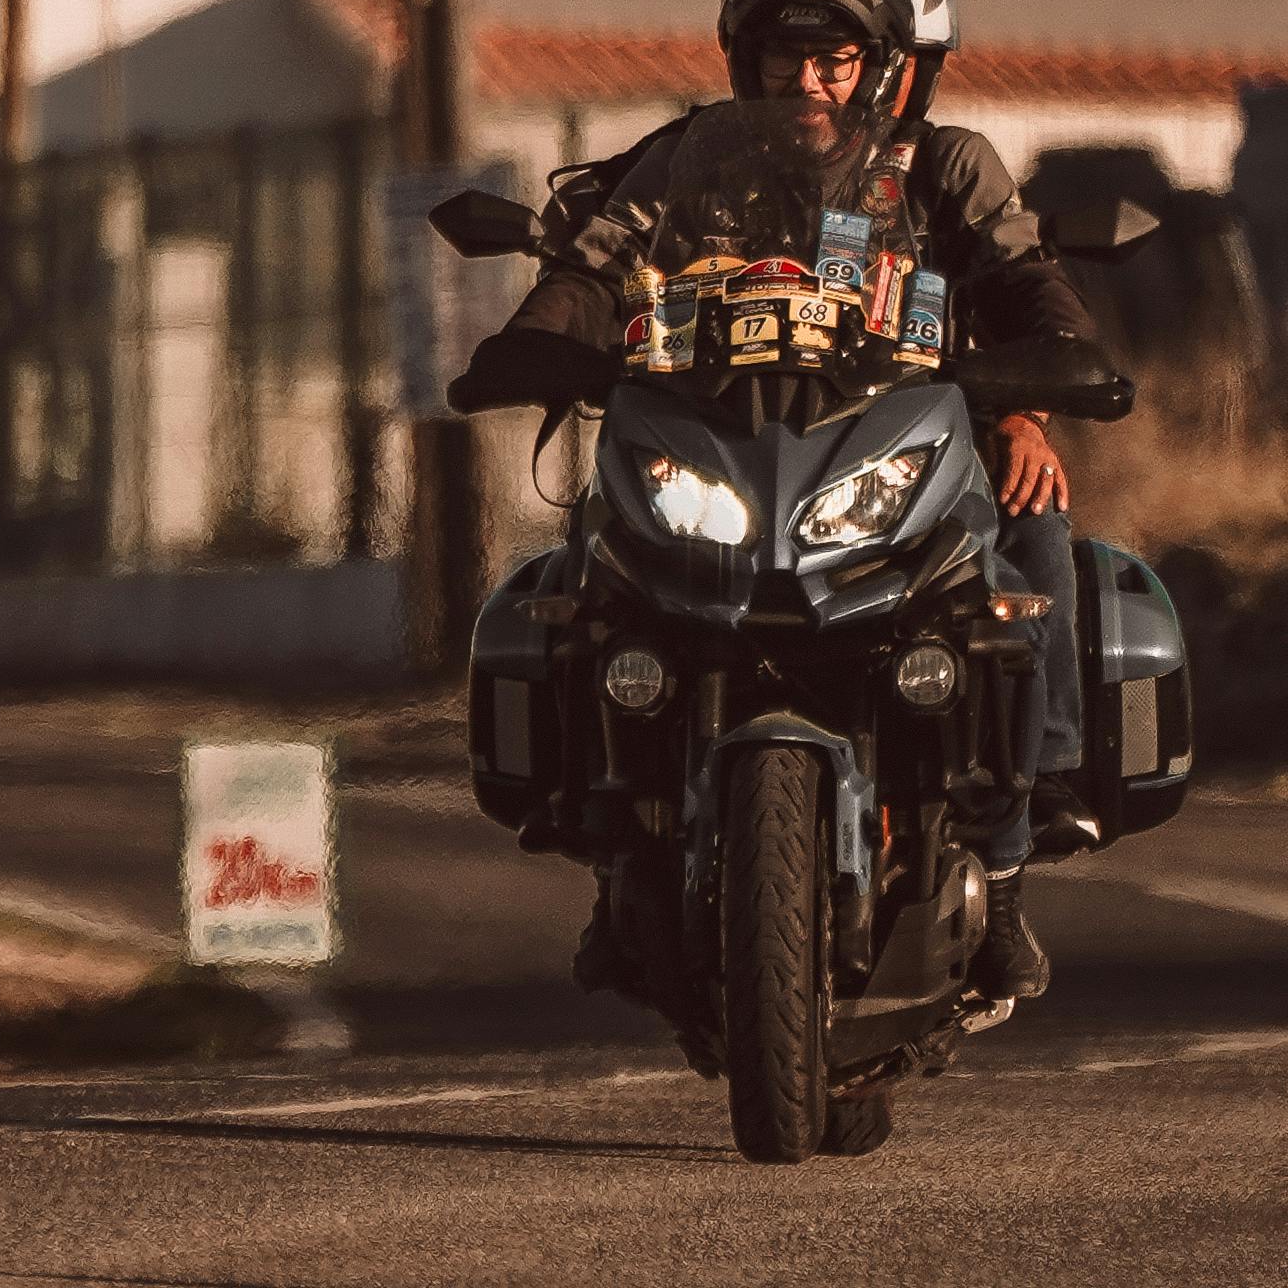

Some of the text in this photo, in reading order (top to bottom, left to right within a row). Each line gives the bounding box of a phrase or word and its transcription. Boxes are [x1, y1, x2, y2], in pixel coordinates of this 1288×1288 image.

[708, 259, 718, 272] 5
[824, 261, 855, 281] 69
[798, 301, 828, 324] 68
[743, 317, 767, 339] 17
